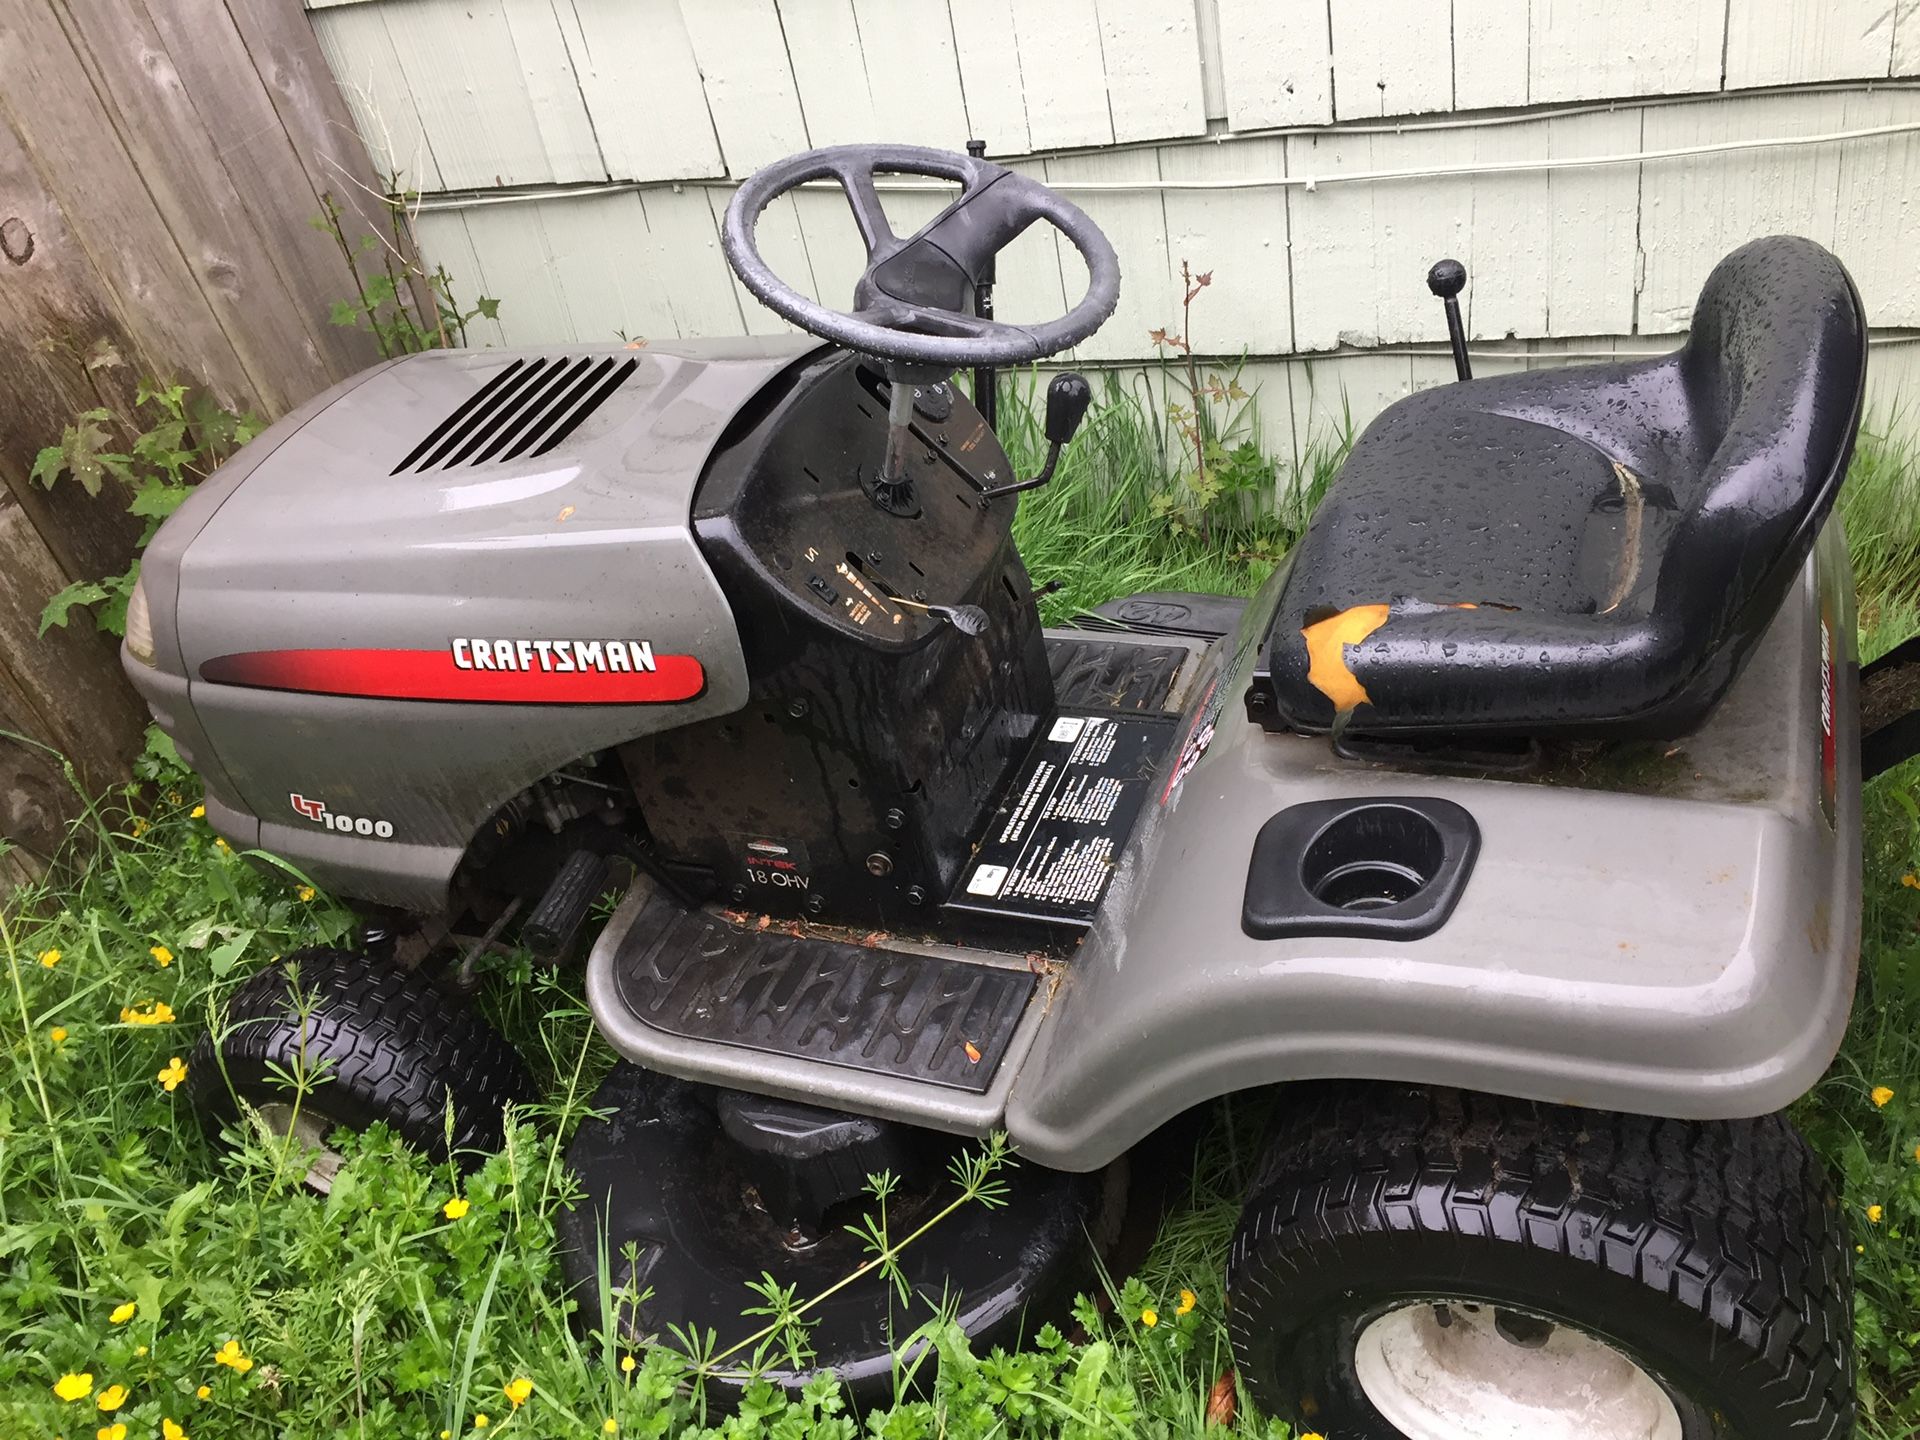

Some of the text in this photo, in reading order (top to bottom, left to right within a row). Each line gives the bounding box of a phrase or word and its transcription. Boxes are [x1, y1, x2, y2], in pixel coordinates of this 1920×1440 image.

[452, 639, 656, 671] CRAFTSMAN
[999, 761, 1047, 843] OPERATING INSTRUCTIONS
[1021, 793, 1040, 820] OWNERS
[1043, 797, 1057, 819] TO STOP
[322, 812, 393, 838] 1000
[747, 868, 809, 889] 18 OHV
